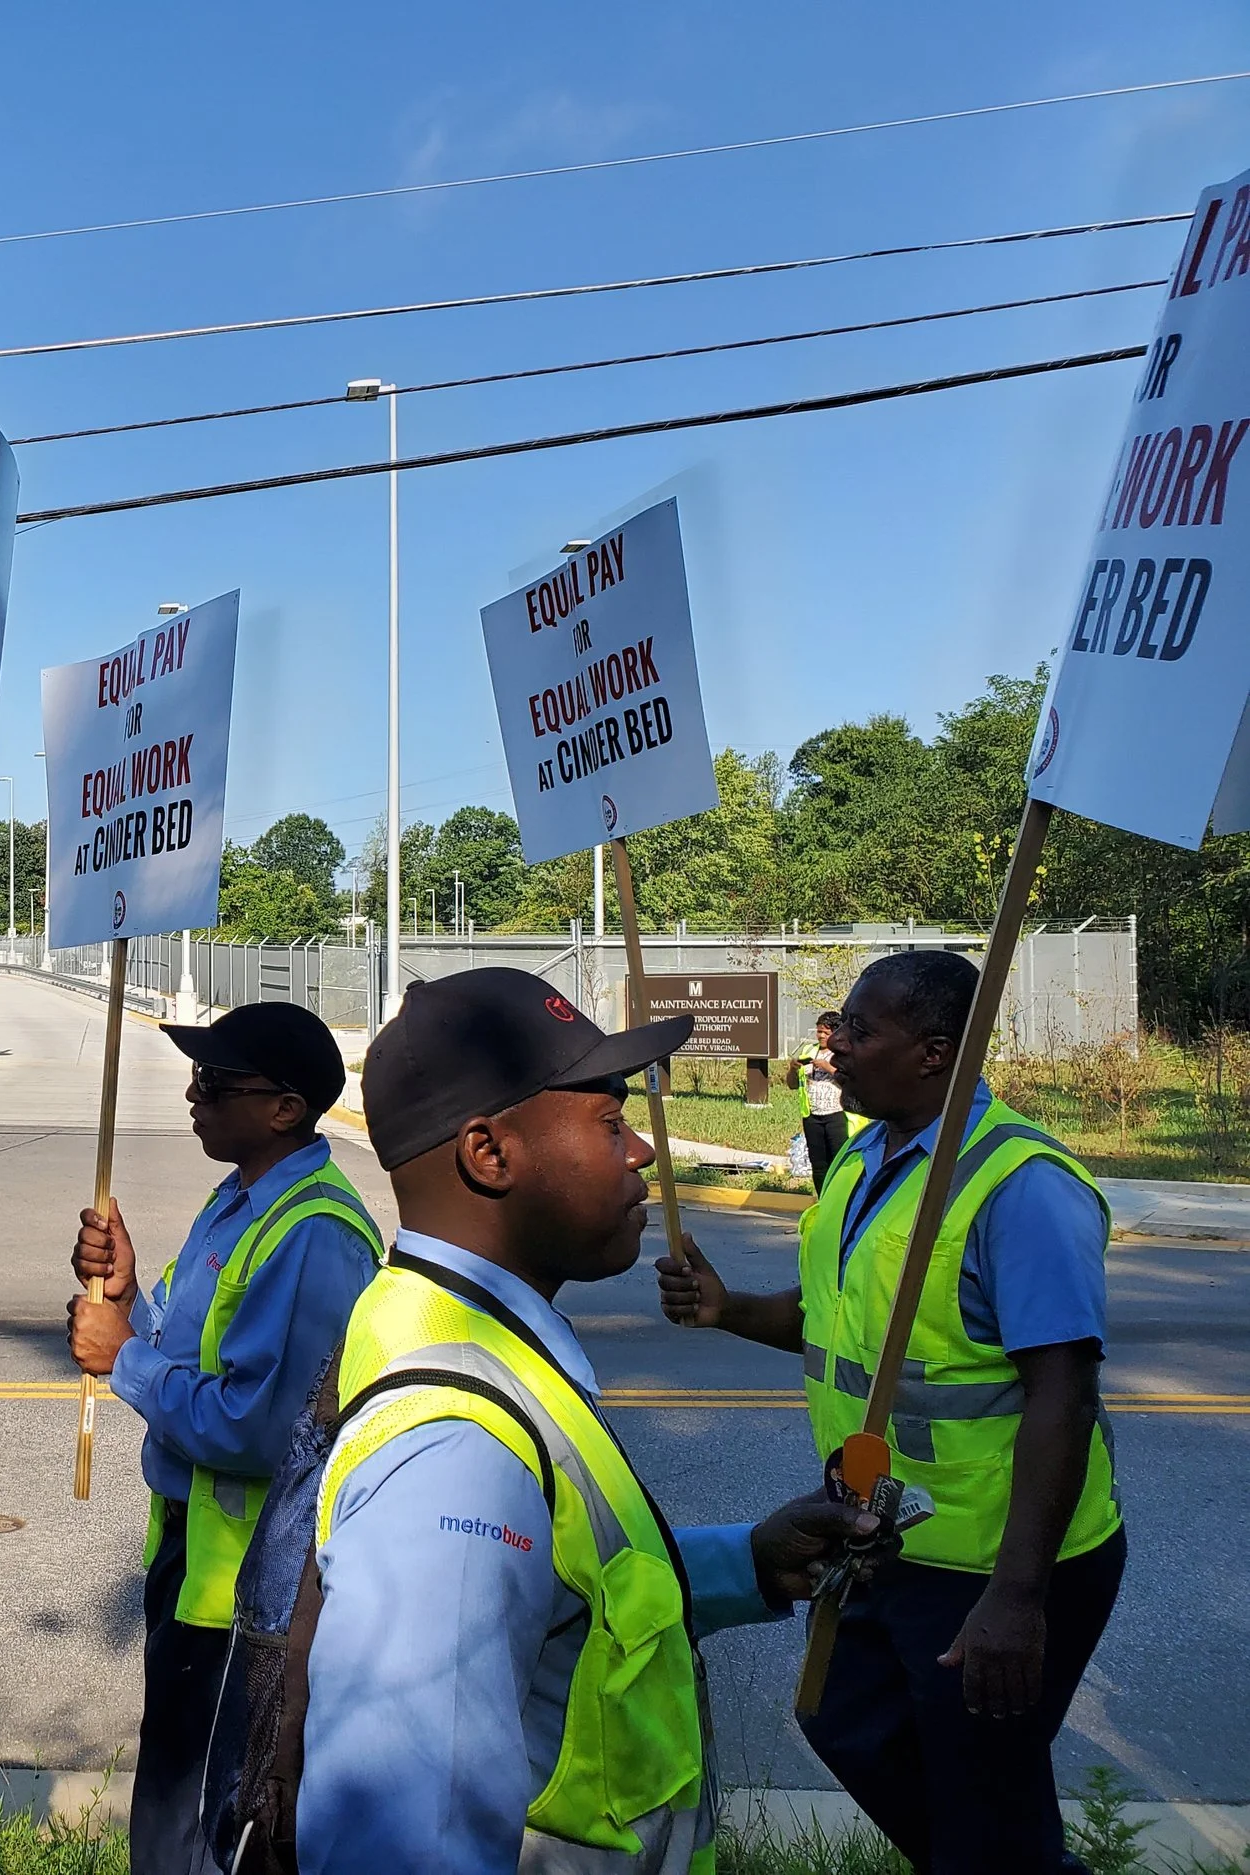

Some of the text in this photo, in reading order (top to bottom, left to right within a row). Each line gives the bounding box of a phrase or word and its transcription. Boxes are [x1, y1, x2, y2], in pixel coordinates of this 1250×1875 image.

[1207, 183, 1250, 288] PA
[1111, 417, 1250, 529] WORK
[587, 533, 625, 597] PAY
[1113, 558, 1213, 662] BED
[150, 618, 190, 681] PAY
[529, 636, 660, 737] EQUAL WORK
[82, 734, 194, 819] EQUAL WORK
[538, 696, 673, 793] AT CINDER BED
[75, 799, 192, 876] AT CINDER BED
[651, 1000, 763, 1009] MAINTENANCE FACILITY
[690, 982, 701, 995] M
[695, 1015, 759, 1023] TROPOLITAN AREA
[439, 1516, 534, 1552] metrobus
